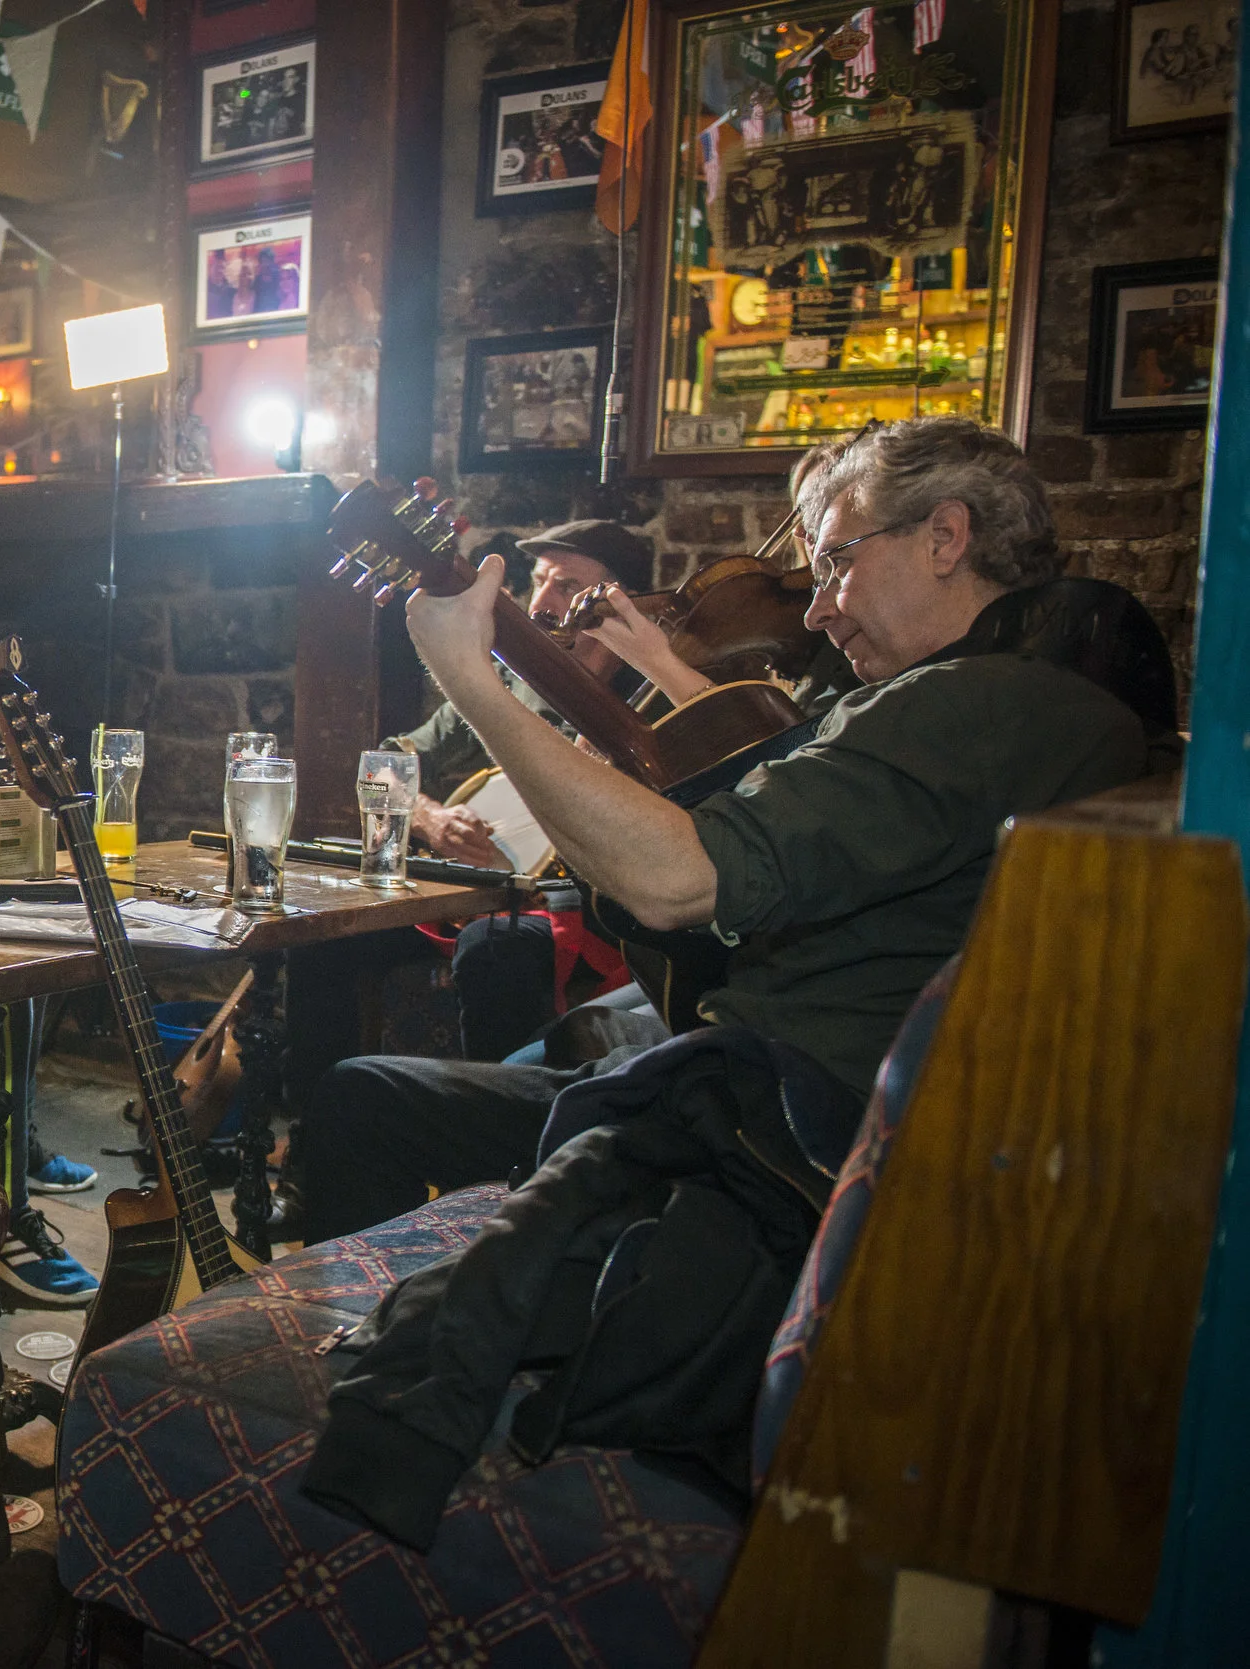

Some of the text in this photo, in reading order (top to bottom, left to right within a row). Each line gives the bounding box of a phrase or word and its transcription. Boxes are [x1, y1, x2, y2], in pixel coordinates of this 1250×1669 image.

[541, 89, 588, 108] DOLANS
[777, 64, 915, 116] Carlsberg
[1173, 287, 1218, 305] DOLA
